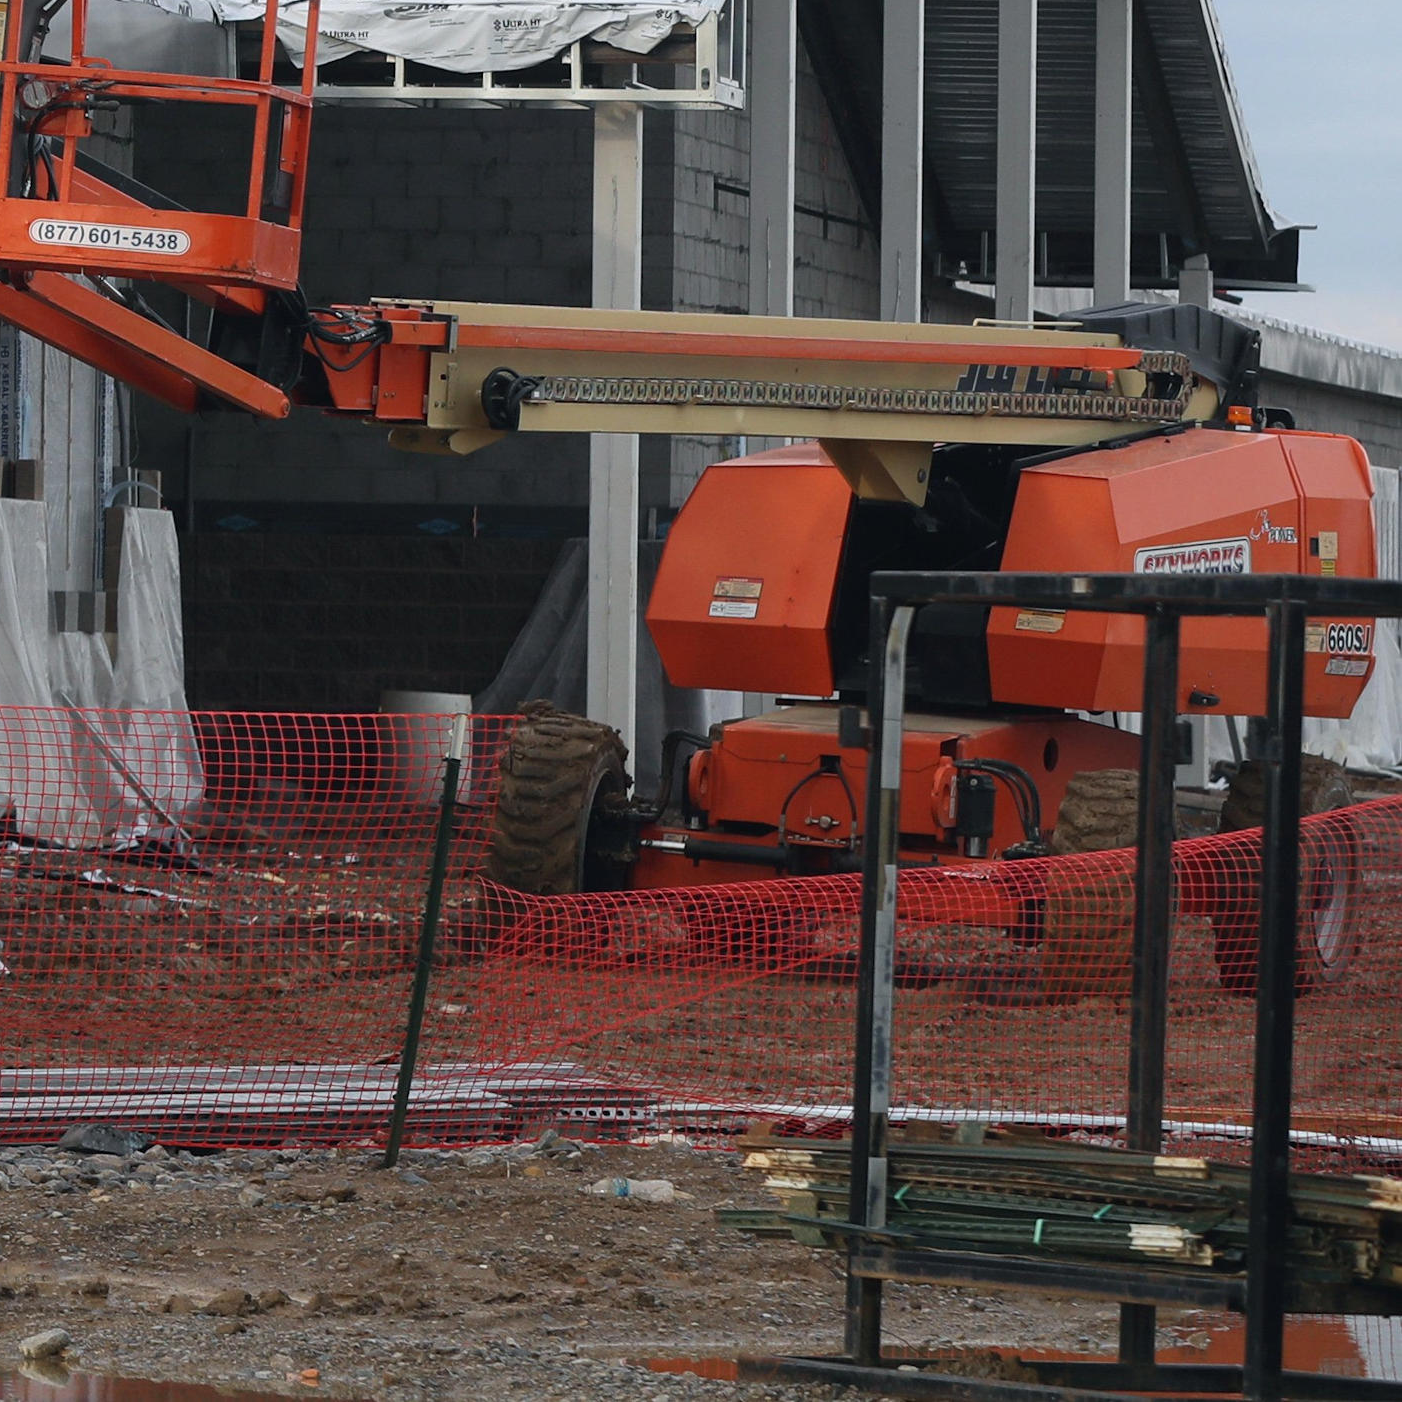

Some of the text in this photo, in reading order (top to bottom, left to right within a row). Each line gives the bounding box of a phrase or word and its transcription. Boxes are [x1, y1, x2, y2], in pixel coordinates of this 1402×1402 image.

[502, 19, 528, 28] ULTRA
[88, 227, 178, 250] 601-5438
[1268, 526, 1297, 544] POWER
[1327, 622, 1372, 655] 660SJ
